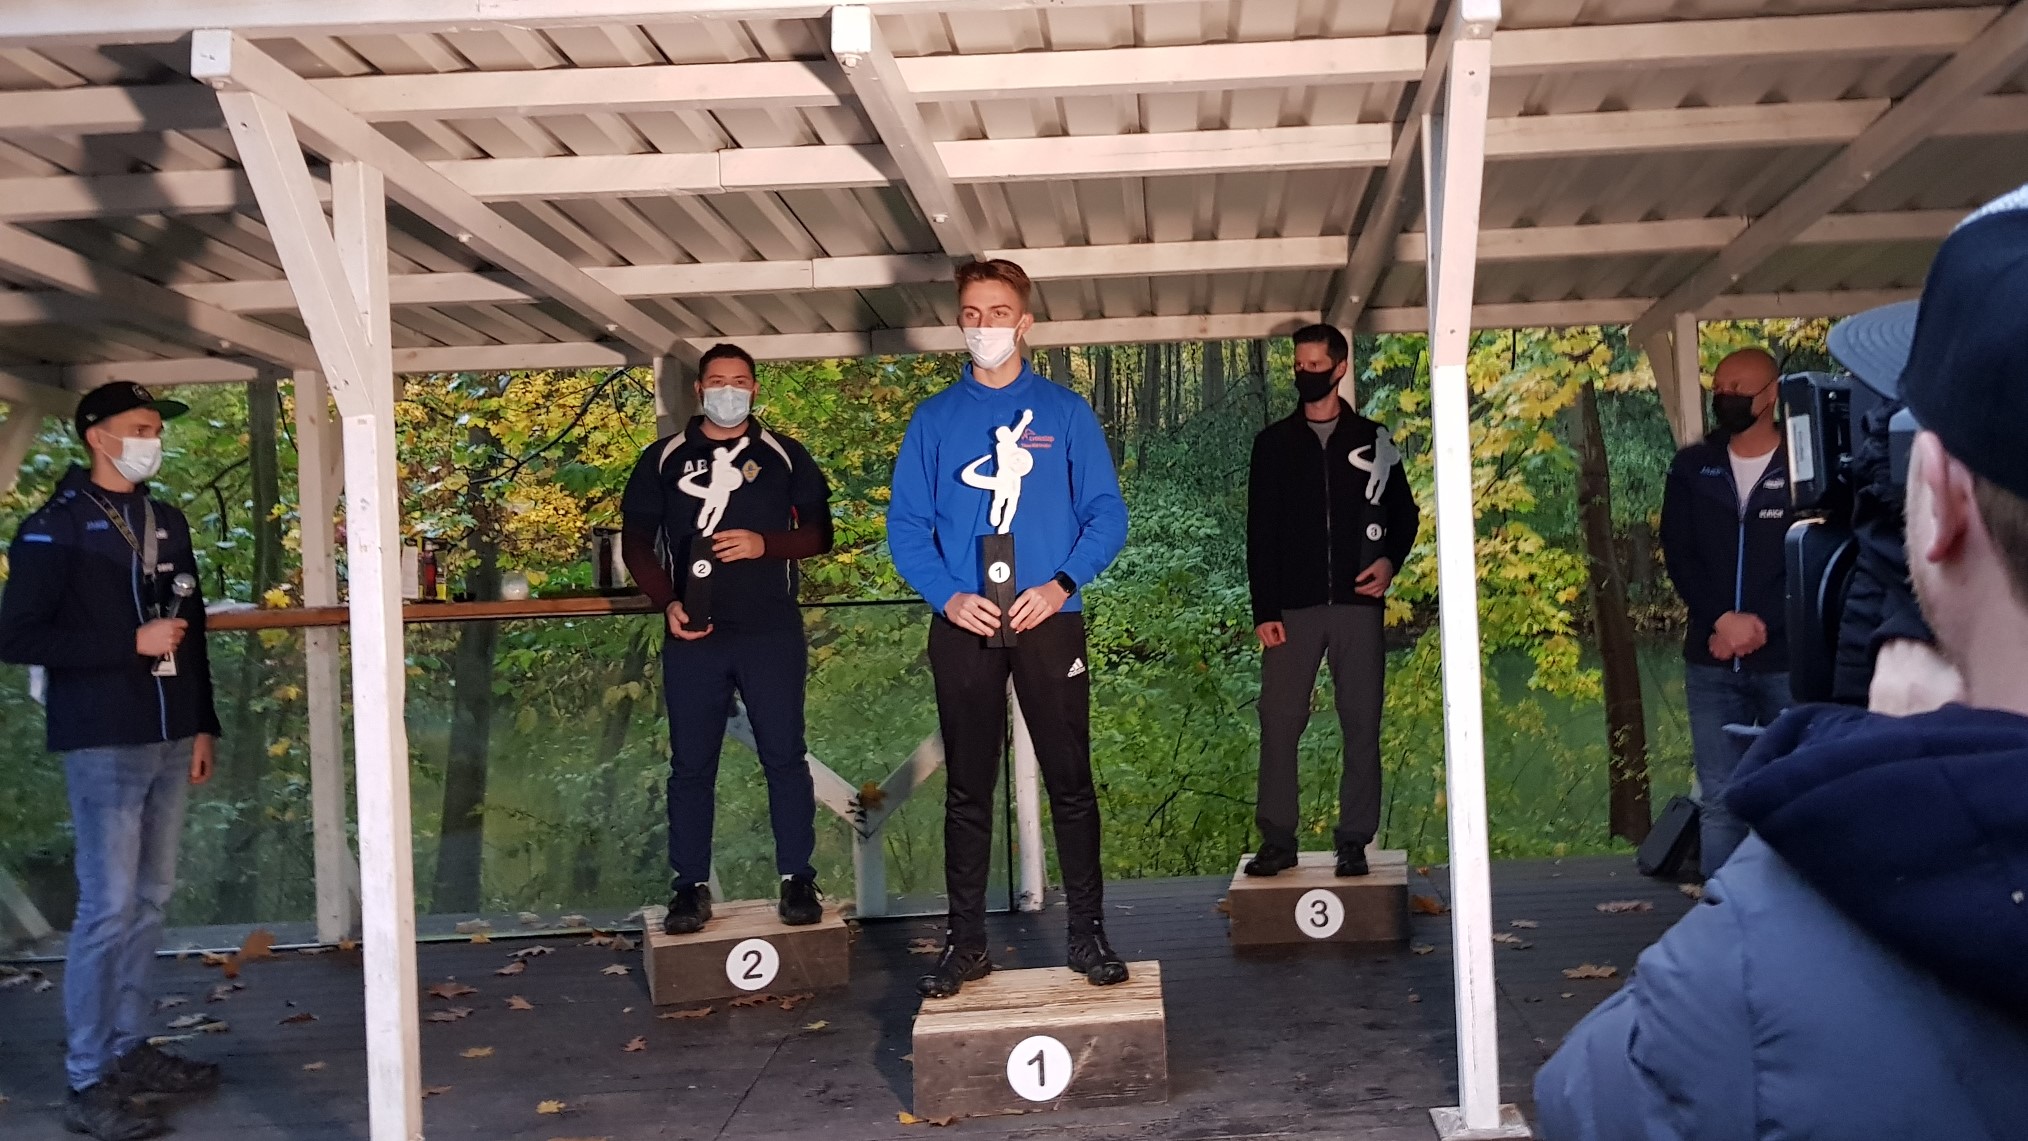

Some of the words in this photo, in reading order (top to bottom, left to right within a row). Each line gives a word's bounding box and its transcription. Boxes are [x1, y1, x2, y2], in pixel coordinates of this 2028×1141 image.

[1370, 527, 1378, 538] 3
[698, 563, 706, 574] 2
[995, 566, 1002, 578] 1
[1309, 899, 1329, 928] 3
[742, 949, 763, 980] 2
[1027, 1049, 1046, 1087] 1
